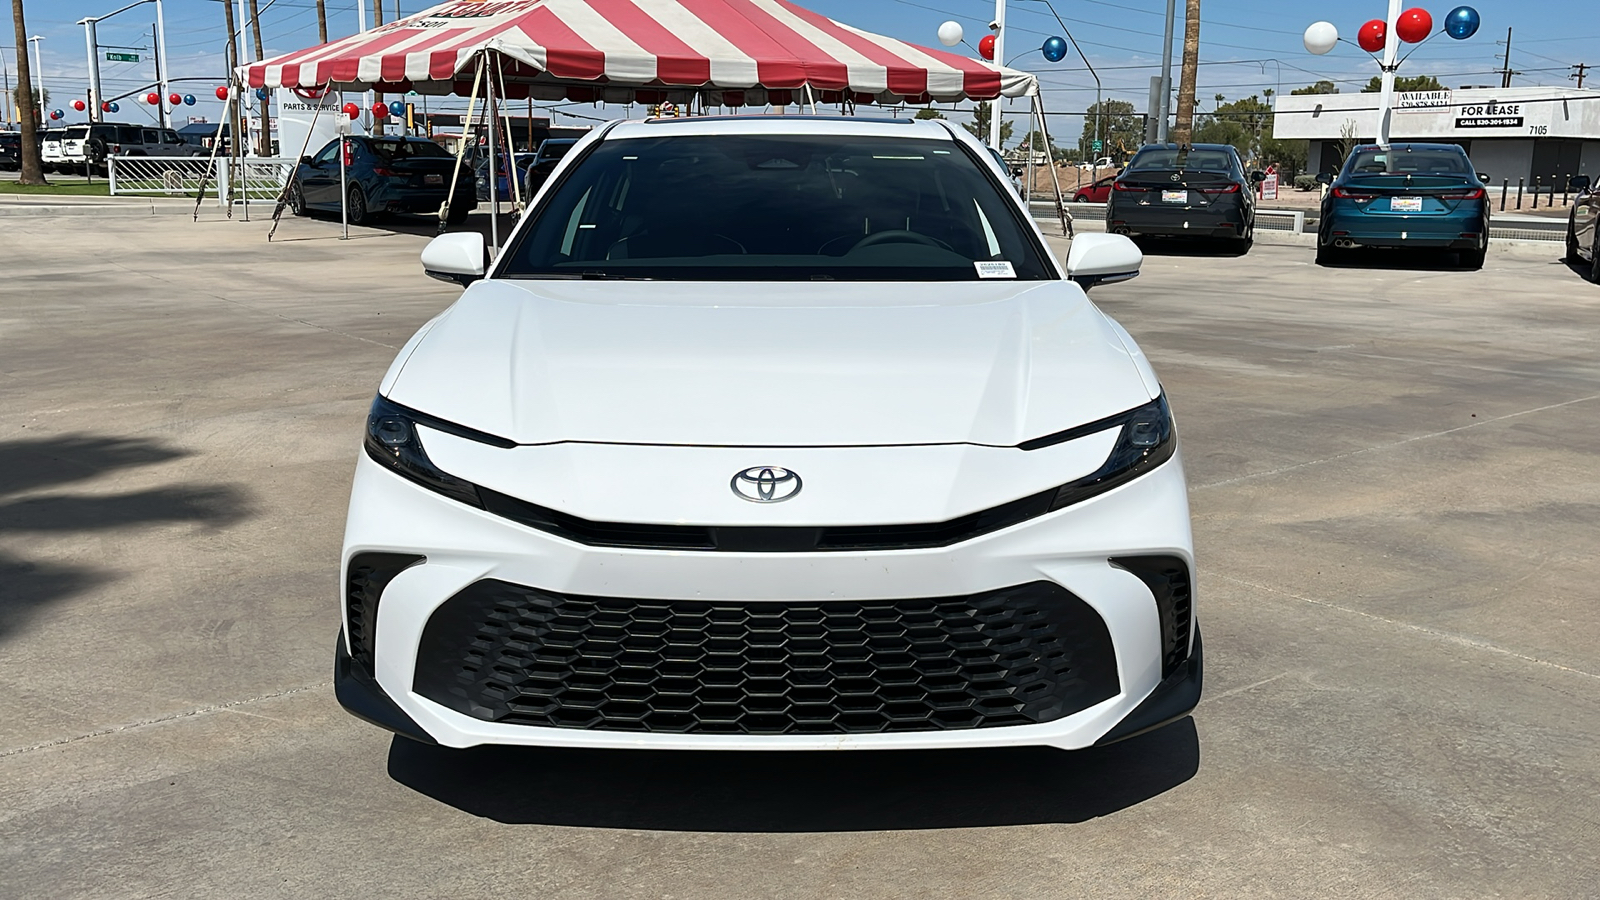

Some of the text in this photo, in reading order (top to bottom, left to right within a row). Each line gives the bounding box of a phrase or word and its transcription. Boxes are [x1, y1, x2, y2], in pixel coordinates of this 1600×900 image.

[1400, 92, 1451, 101] AVAILABLE
[1461, 105, 1520, 116] FOR LEASE
[1529, 125, 1548, 135] 7105
